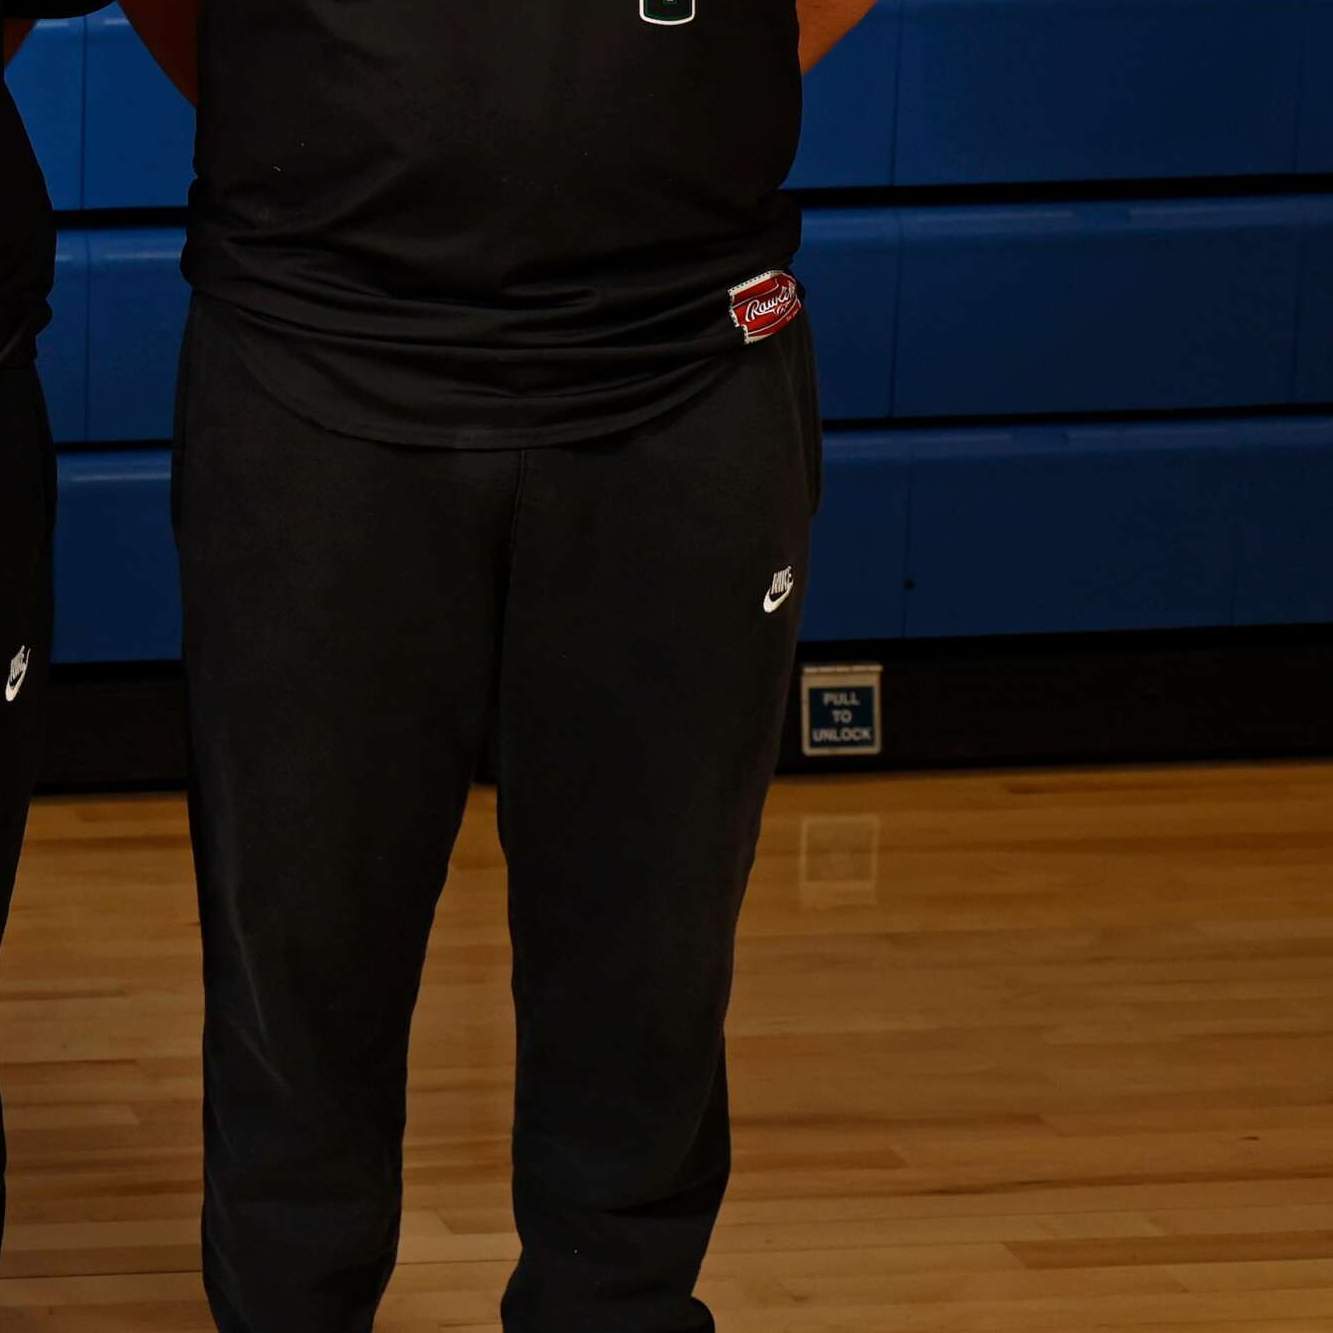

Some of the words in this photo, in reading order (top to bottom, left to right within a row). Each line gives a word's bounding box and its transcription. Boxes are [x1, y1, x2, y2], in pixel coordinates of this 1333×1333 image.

[823, 692, 861, 706] PULL
[832, 709, 853, 724] TO
[812, 727, 872, 742] UNLOCK
